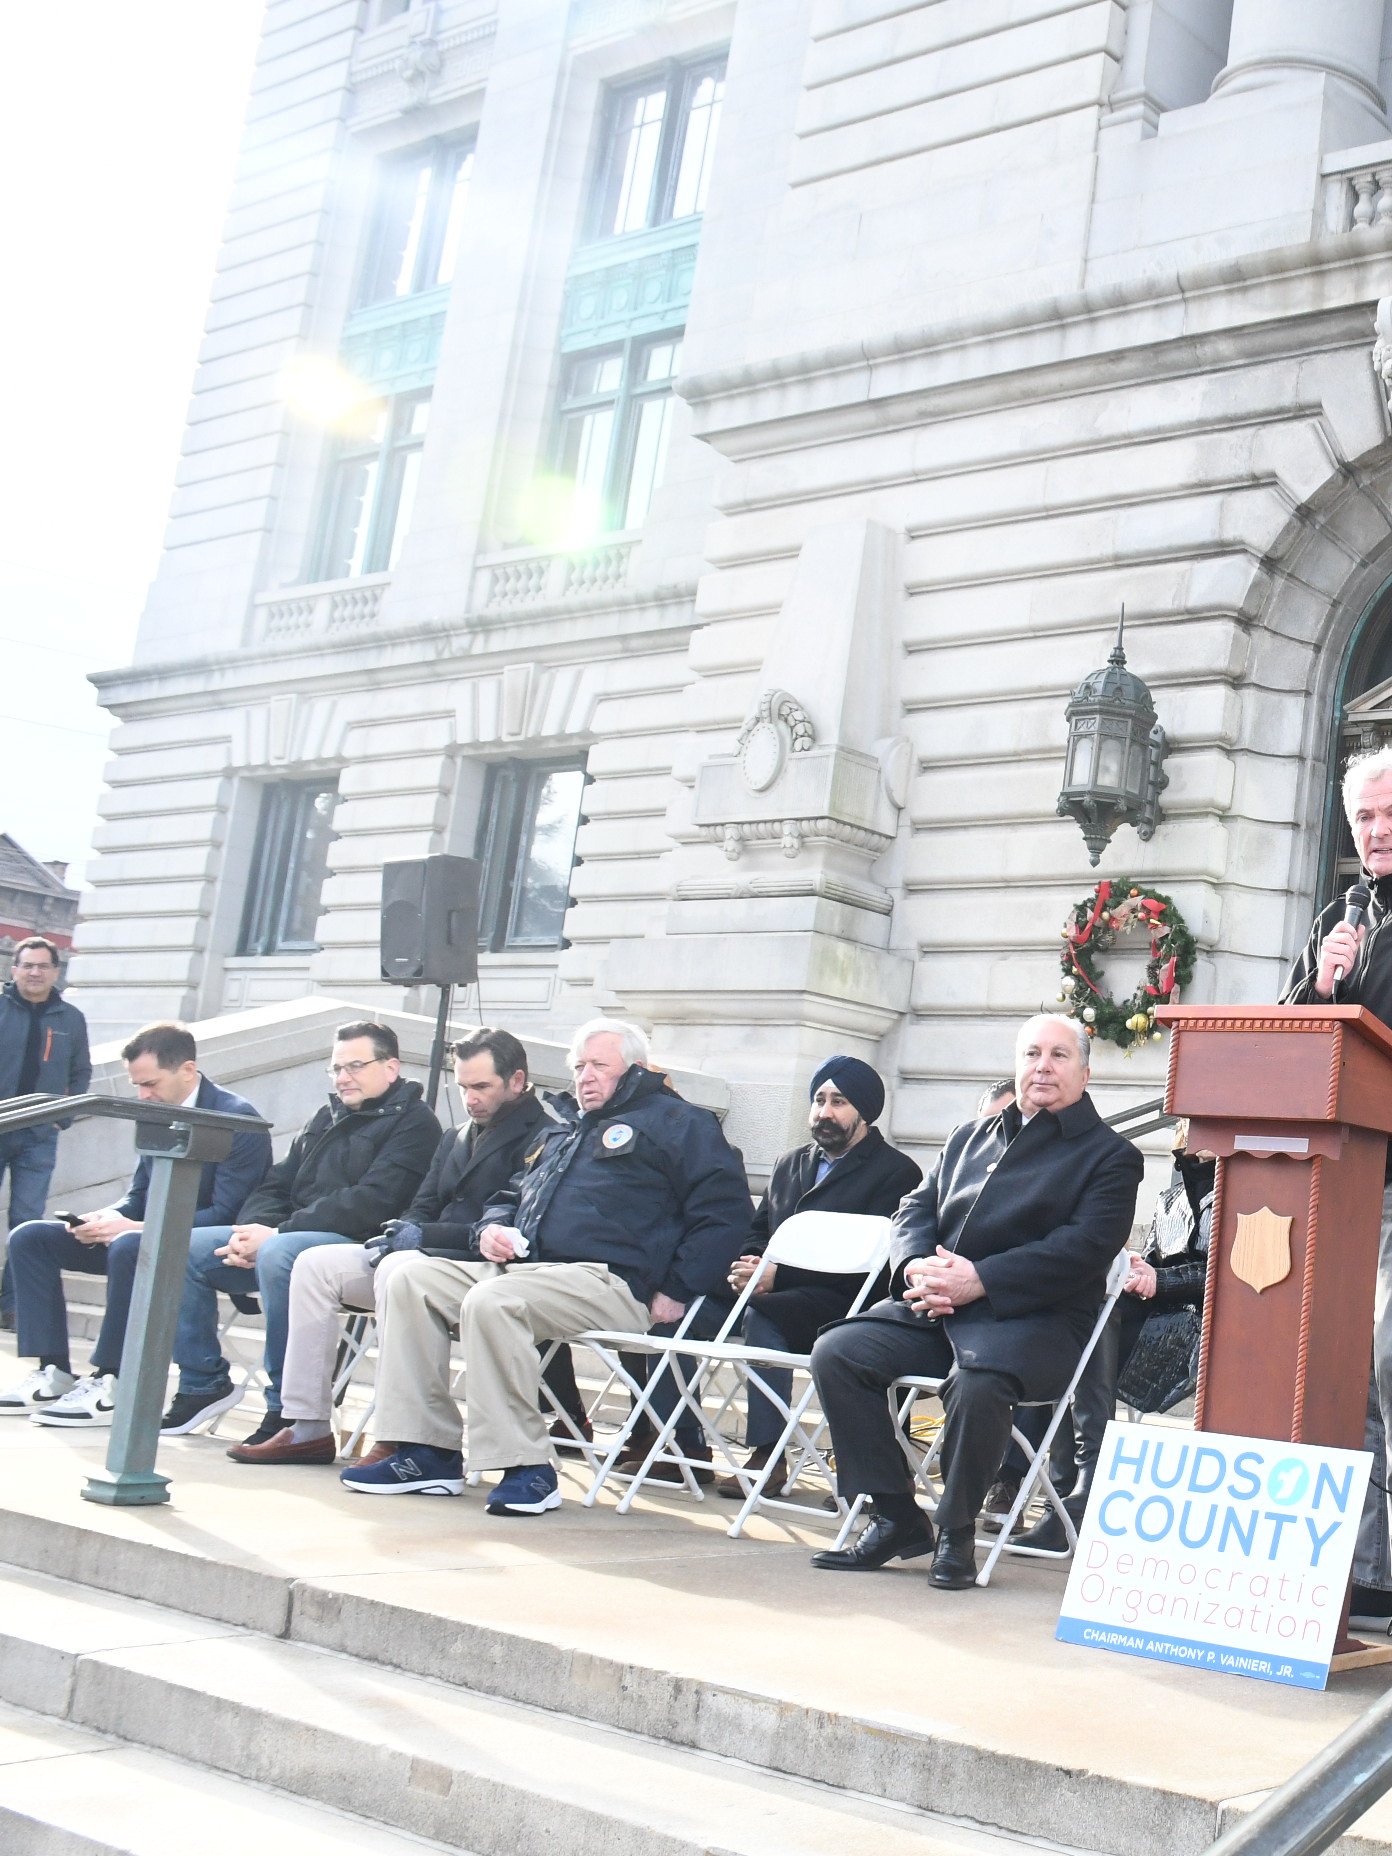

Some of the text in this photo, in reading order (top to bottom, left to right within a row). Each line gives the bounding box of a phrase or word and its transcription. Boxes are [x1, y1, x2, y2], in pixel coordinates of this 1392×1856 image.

[1108, 1436, 1354, 1514] HUDSON
[1098, 1489, 1343, 1567] COUNTY
[1080, 1573, 1322, 1643] Organization
[1086, 1540, 1329, 1607] Democratic
[1083, 1628, 1295, 1678] CHAIRMAN ANTHONY P. VAINIERI, JR.
